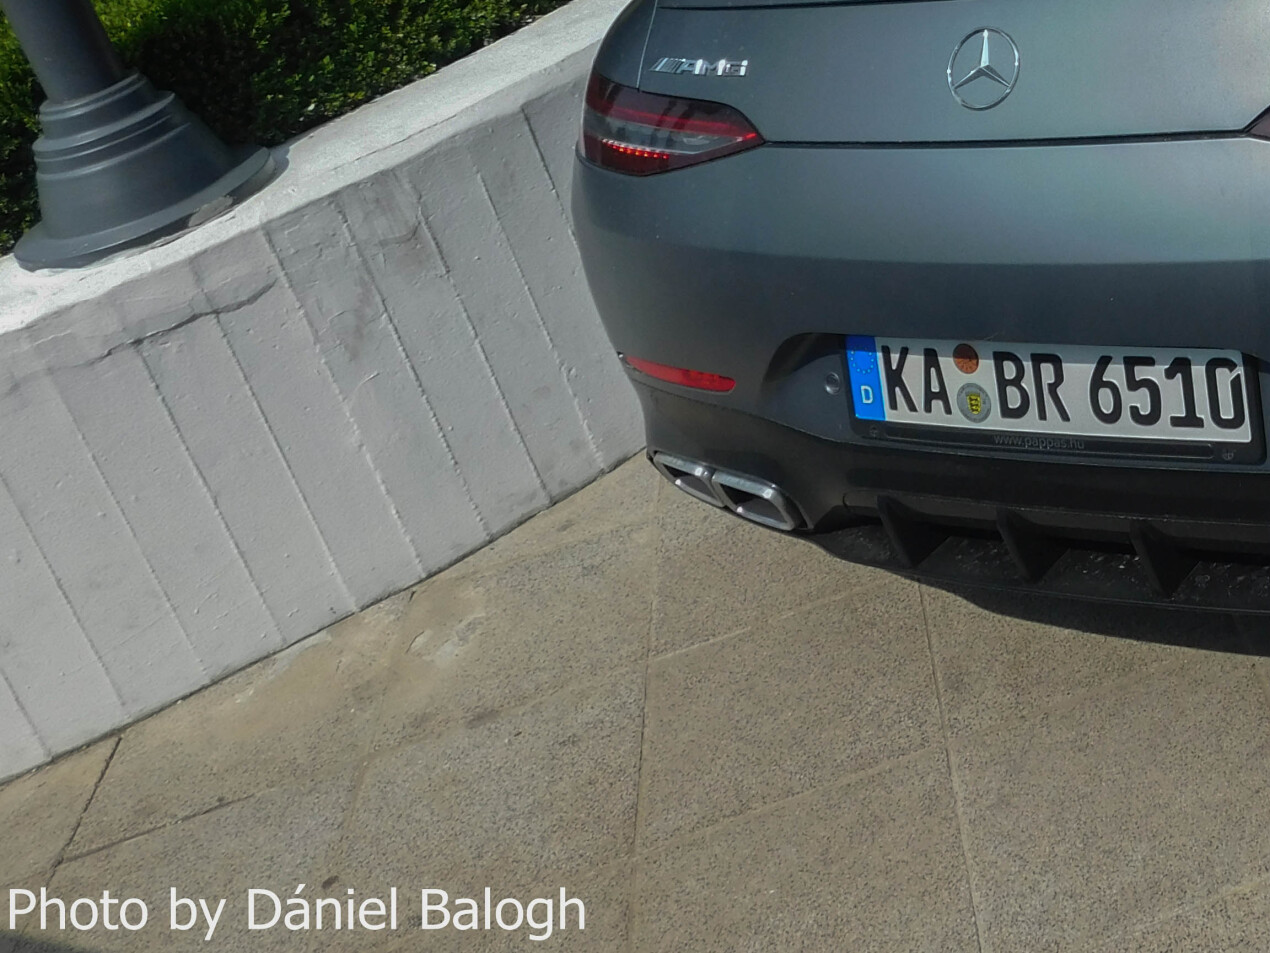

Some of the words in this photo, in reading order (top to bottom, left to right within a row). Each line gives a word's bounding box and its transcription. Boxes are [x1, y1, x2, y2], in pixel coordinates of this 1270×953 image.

[668, 58, 748, 77] AMG
[860, 385, 874, 404] D
[880, 344, 953, 416] KA
[991, 350, 1071, 423] BR
[1088, 354, 1246, 430] 6510
[993, 434, 1085, 450] www.pappas.hu
